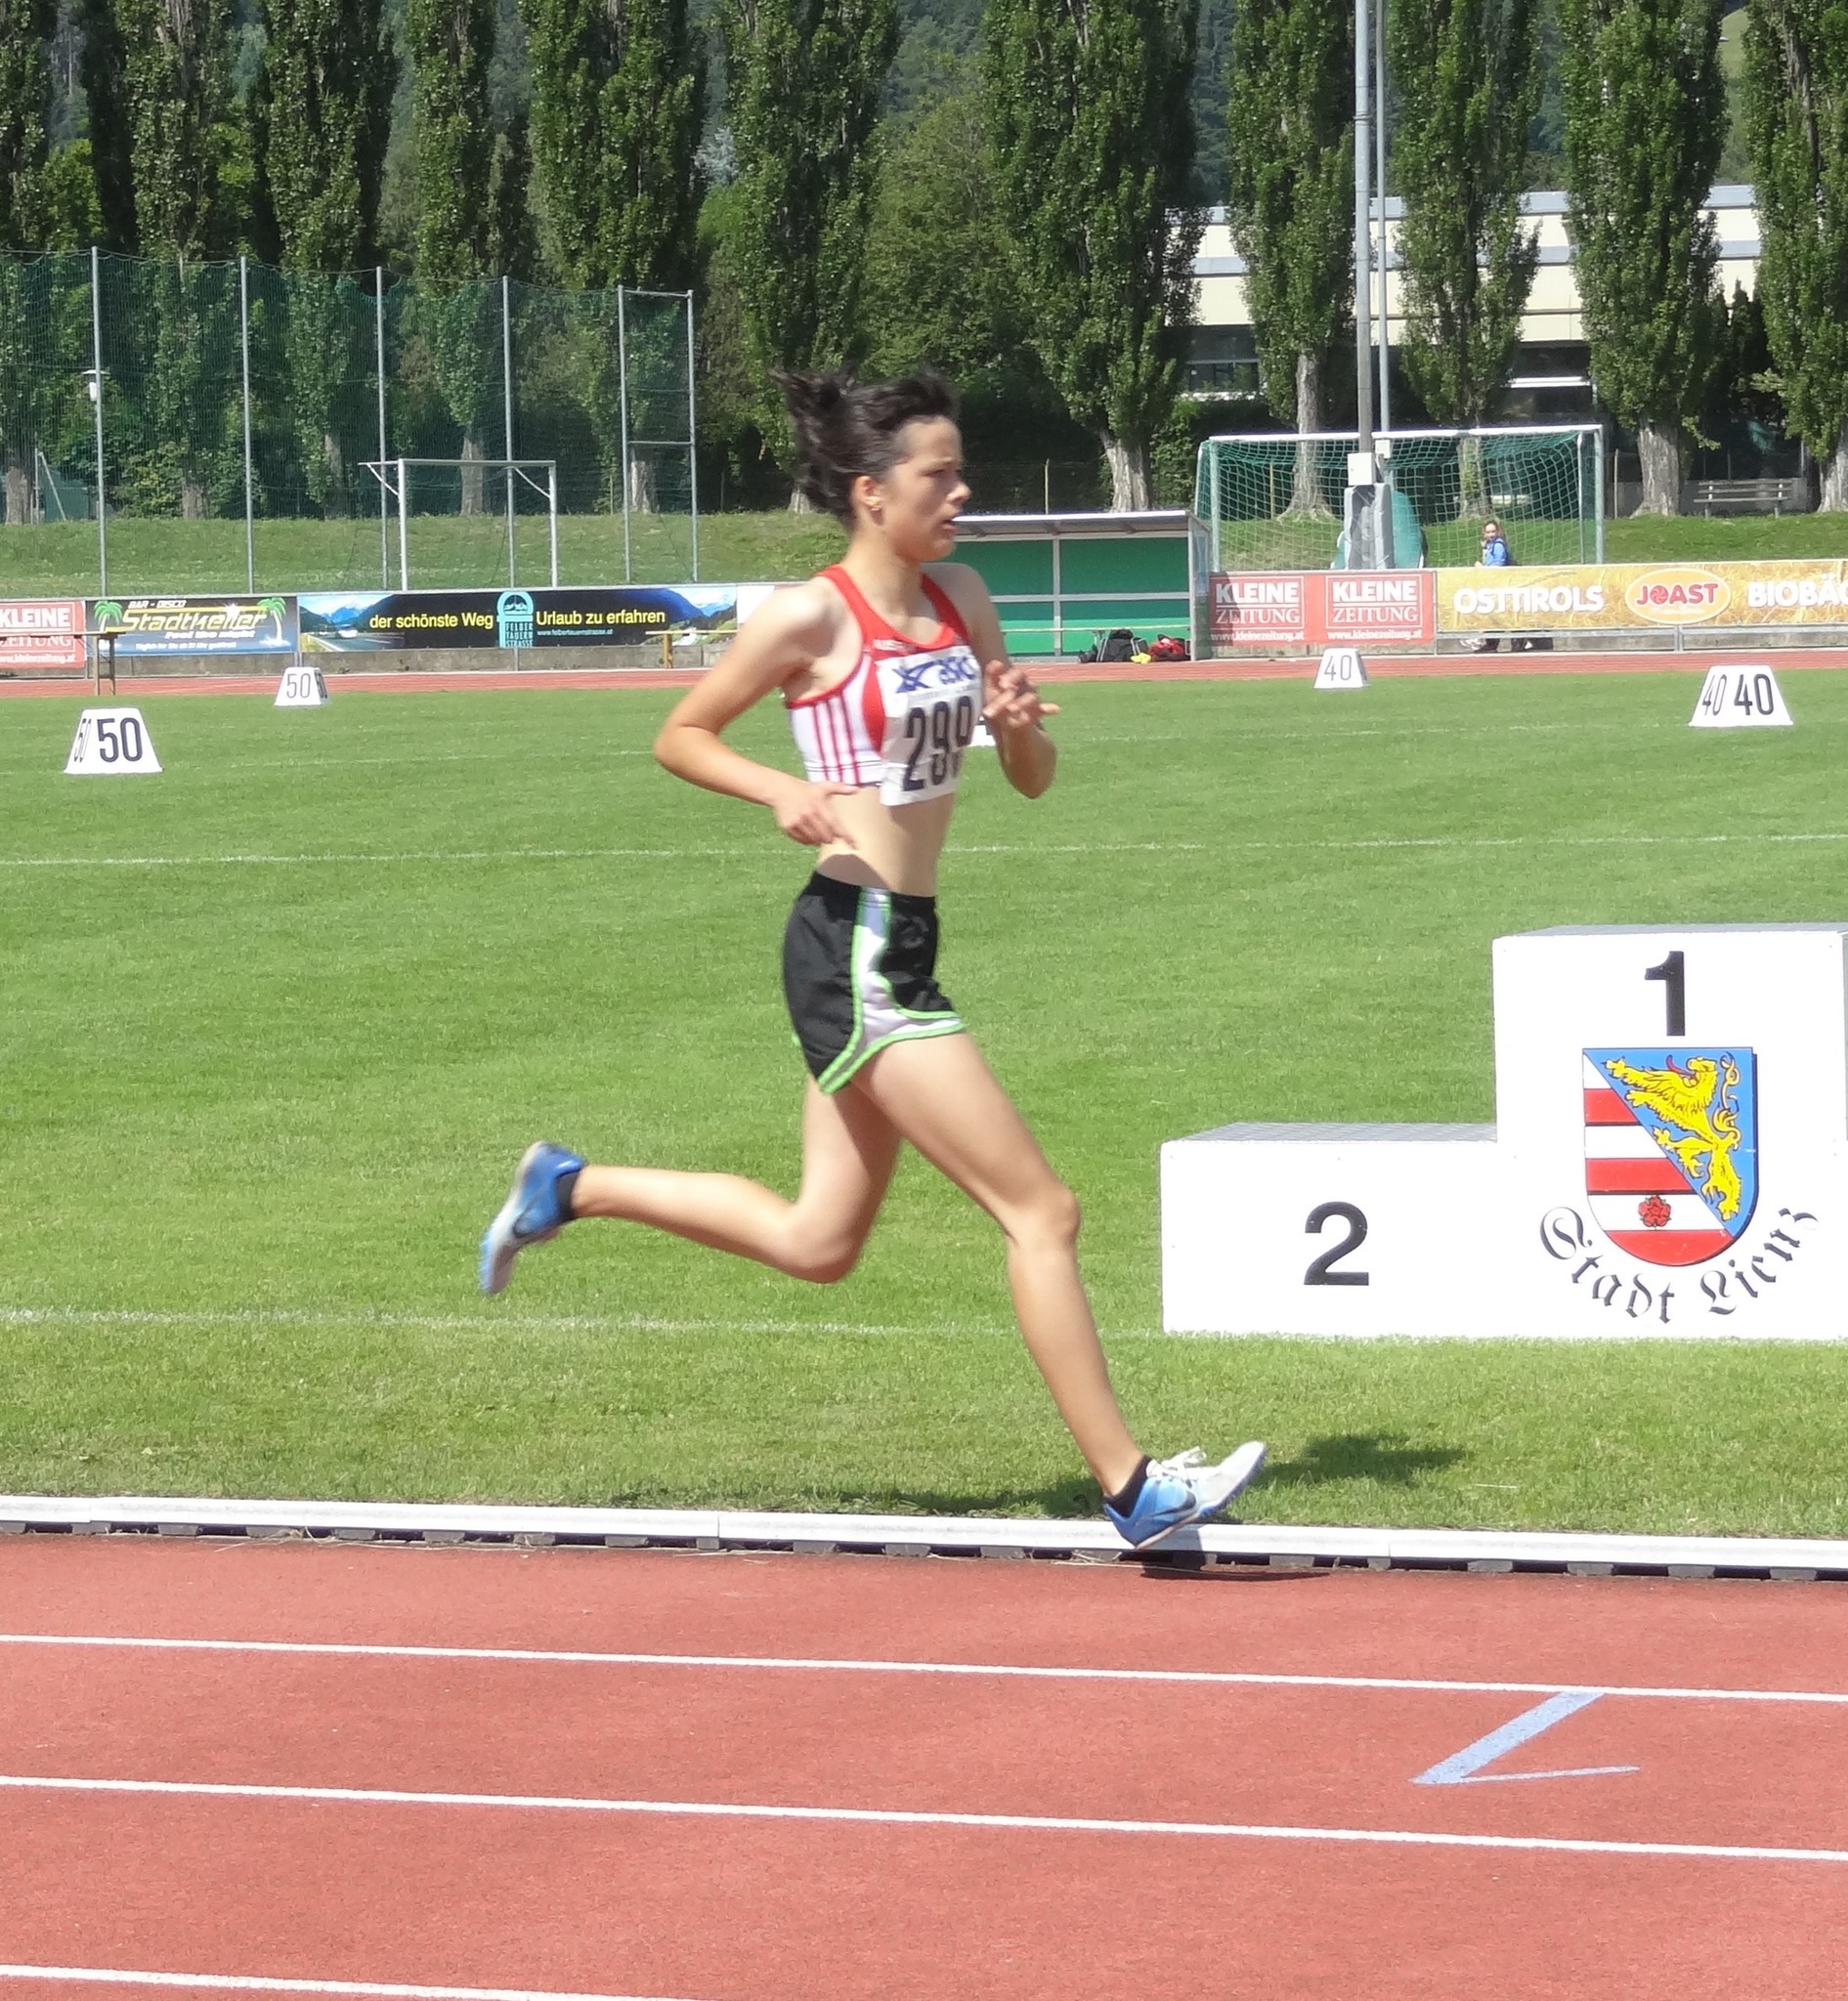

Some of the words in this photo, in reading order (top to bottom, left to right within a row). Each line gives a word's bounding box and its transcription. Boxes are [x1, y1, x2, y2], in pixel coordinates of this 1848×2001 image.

[1216, 582, 1300, 603] KLEINE
[1333, 580, 1416, 602] KLEINE
[1453, 585, 1605, 615] OSTTIROLS
[1637, 583, 1719, 605] JOAST
[128, 600, 150, 609] BAR
[156, 599, 187, 609] DISCO
[1216, 608, 1300, 623] ZEITUNG
[1333, 606, 1418, 623] ZEITUNG
[369, 615, 393, 628] der
[396, 614, 458, 628] schönste
[461, 613, 494, 629] Weg
[537, 611, 582, 625] Urlaub
[585, 614, 602, 624] zu
[606, 610, 666, 624] erfahren
[1327, 630, 1423, 640] www.kleinezeitung.at
[1324, 655, 1353, 680] 40
[286, 673, 311, 699] 50
[1702, 674, 1727, 716] 40
[1734, 673, 1774, 715] 40
[97, 717, 143, 762] 50
[1644, 951, 1686, 1036] 1
[1304, 1202, 1370, 1286] 2
[1539, 1206, 1676, 1324] Stadt
[1700, 1208, 1819, 1315] Lienz
